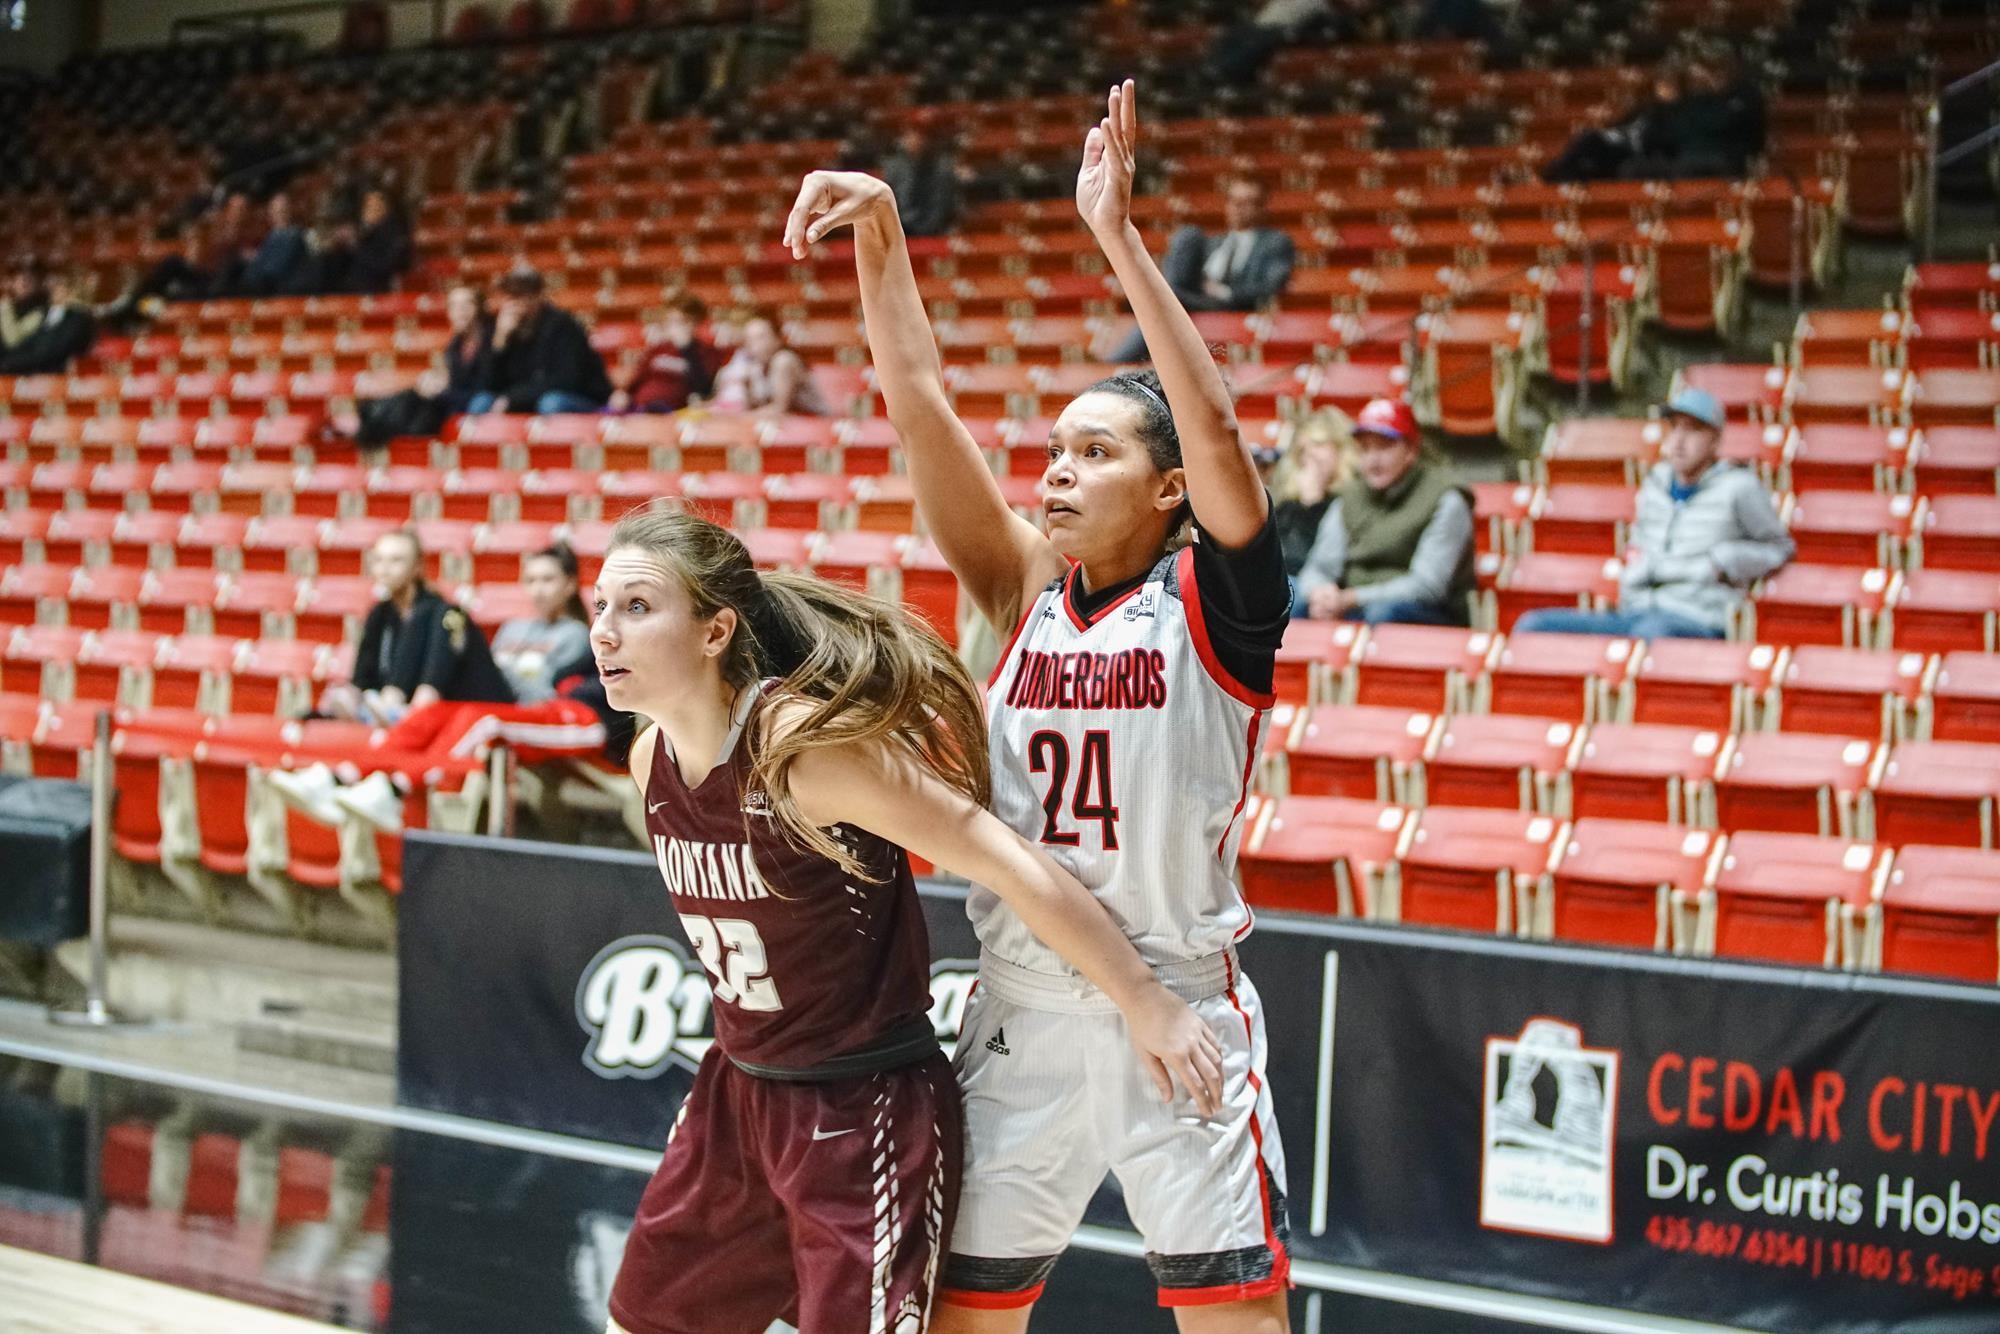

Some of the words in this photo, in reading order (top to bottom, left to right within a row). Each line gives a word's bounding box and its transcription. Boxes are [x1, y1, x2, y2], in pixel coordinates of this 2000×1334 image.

[1028, 729, 1120, 851] 24
[1647, 1052, 1847, 1143] CEDAR
[1867, 1075, 2000, 1161] CITY
[1646, 1145, 1717, 1204] Dr.
[1726, 1154, 1864, 1225] Curtis
[1831, 1240, 1893, 1279] 1180
[1925, 1253, 1985, 1300] Sage
